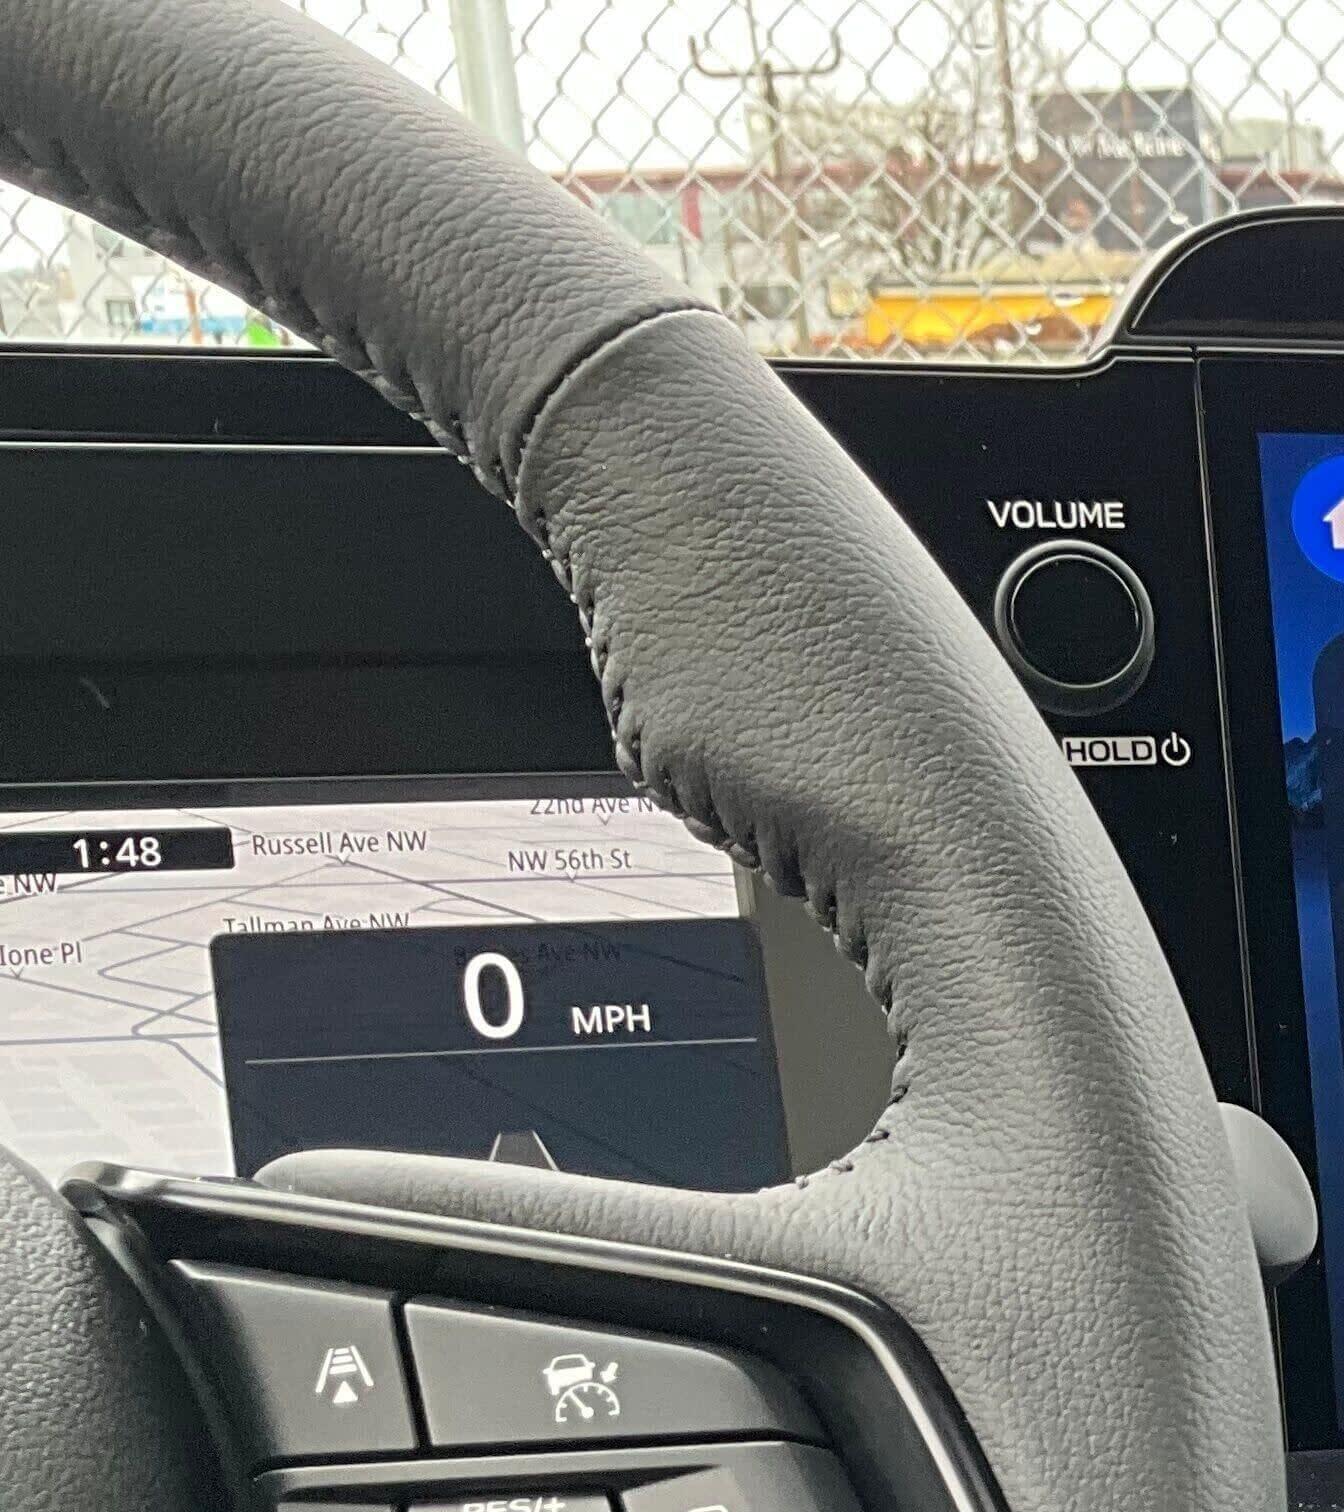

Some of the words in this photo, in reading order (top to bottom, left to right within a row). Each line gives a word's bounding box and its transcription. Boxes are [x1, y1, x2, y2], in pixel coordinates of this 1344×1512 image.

[987, 500, 1126, 529] VOLUME
[1065, 739, 1153, 762] HOLD
[592, 798, 630, 814] Ave
[73, 836, 162, 868] 1:48
[253, 832, 332, 856] Russell
[340, 832, 379, 852] Ave
[387, 830, 428, 852] NW
[508, 850, 547, 872] NW
[555, 849, 604, 871] 56th
[610, 848, 632, 870] St
[14, 873, 57, 893] NW
[61, 941, 82, 964] Pl
[462, 952, 525, 1038] 0
[571, 1004, 652, 1036] MPH
